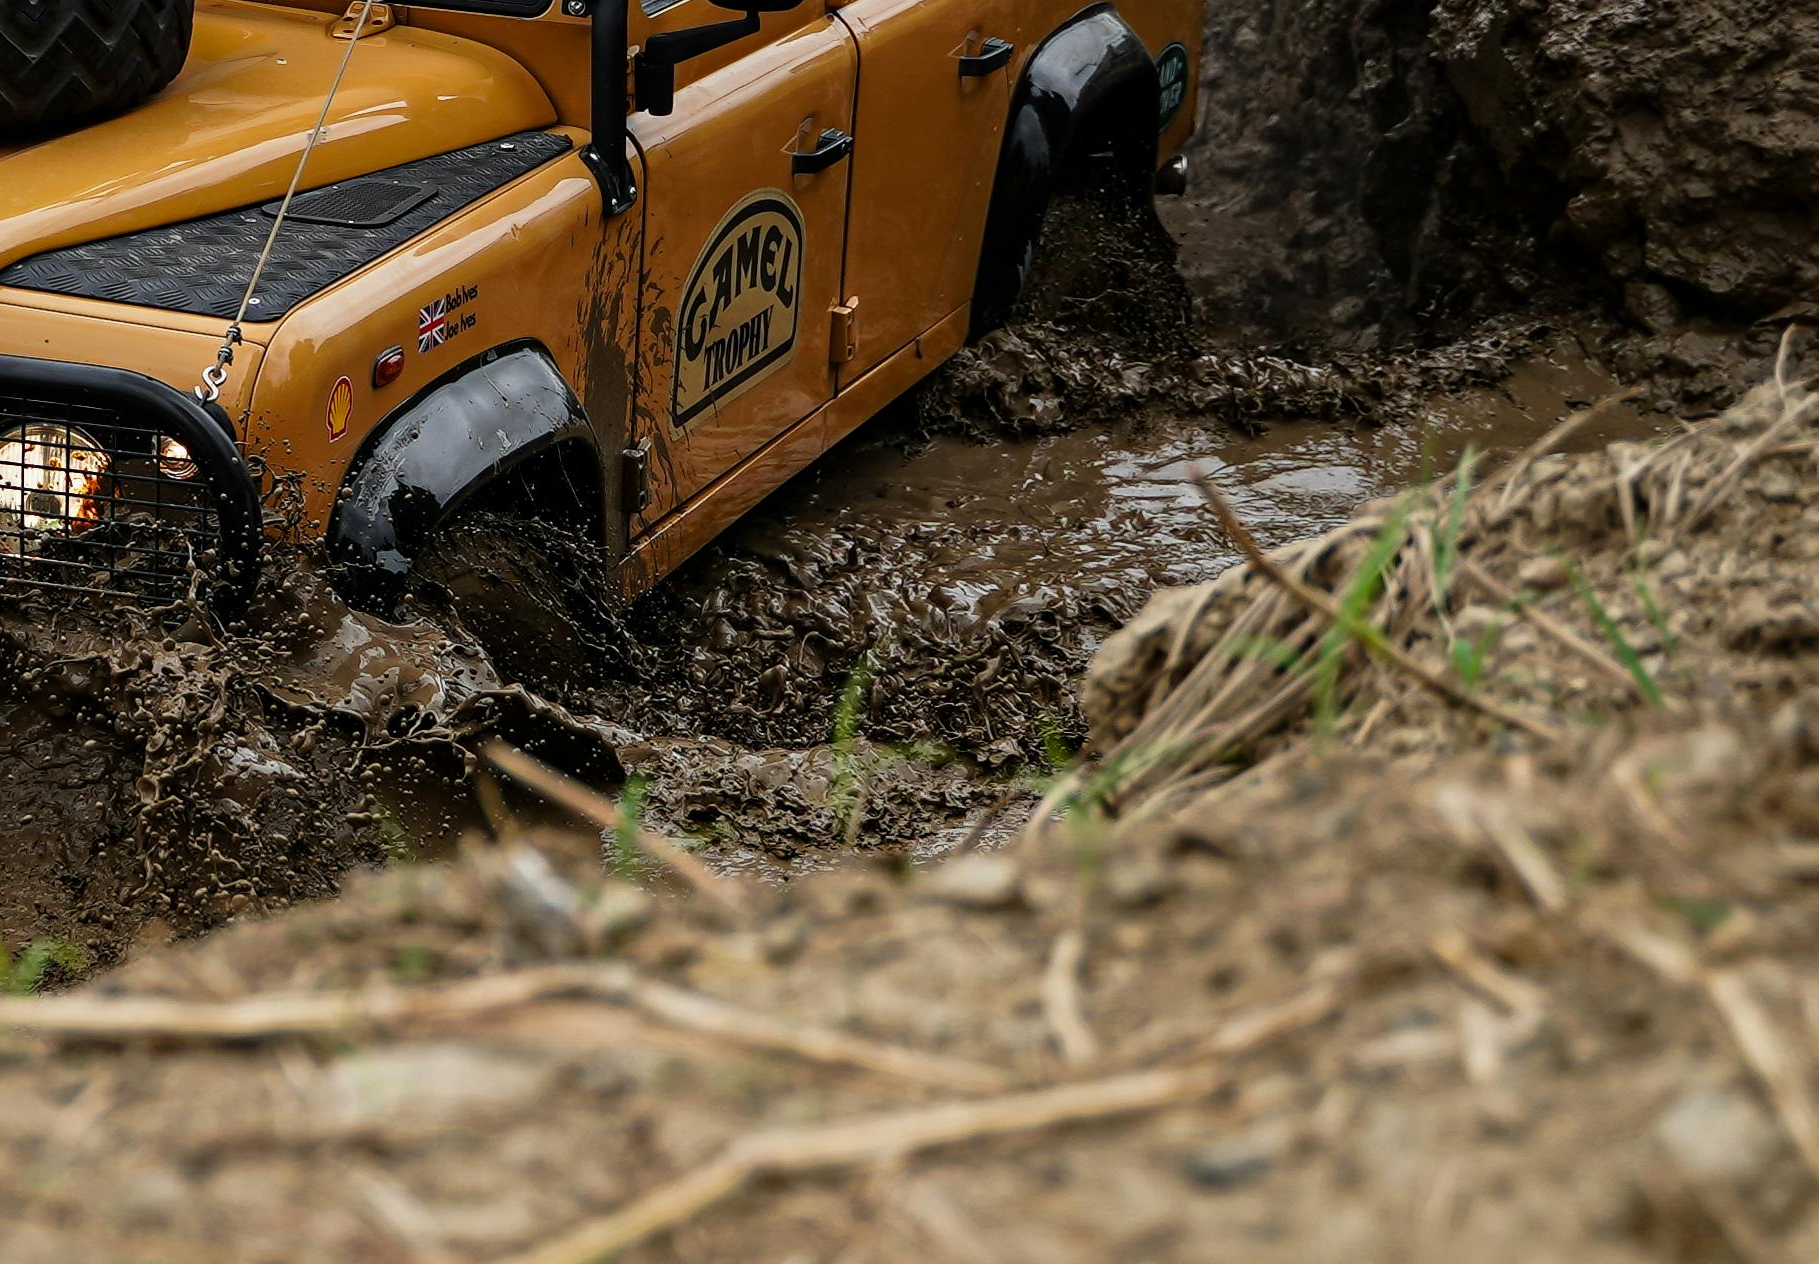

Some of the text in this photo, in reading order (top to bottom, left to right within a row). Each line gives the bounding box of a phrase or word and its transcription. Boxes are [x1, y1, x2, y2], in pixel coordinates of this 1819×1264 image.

[446, 288, 461, 313] Bob
[684, 224, 794, 361] CAMEL
[445, 313, 477, 340] Joe Ives
[703, 304, 774, 392] TROPHY
